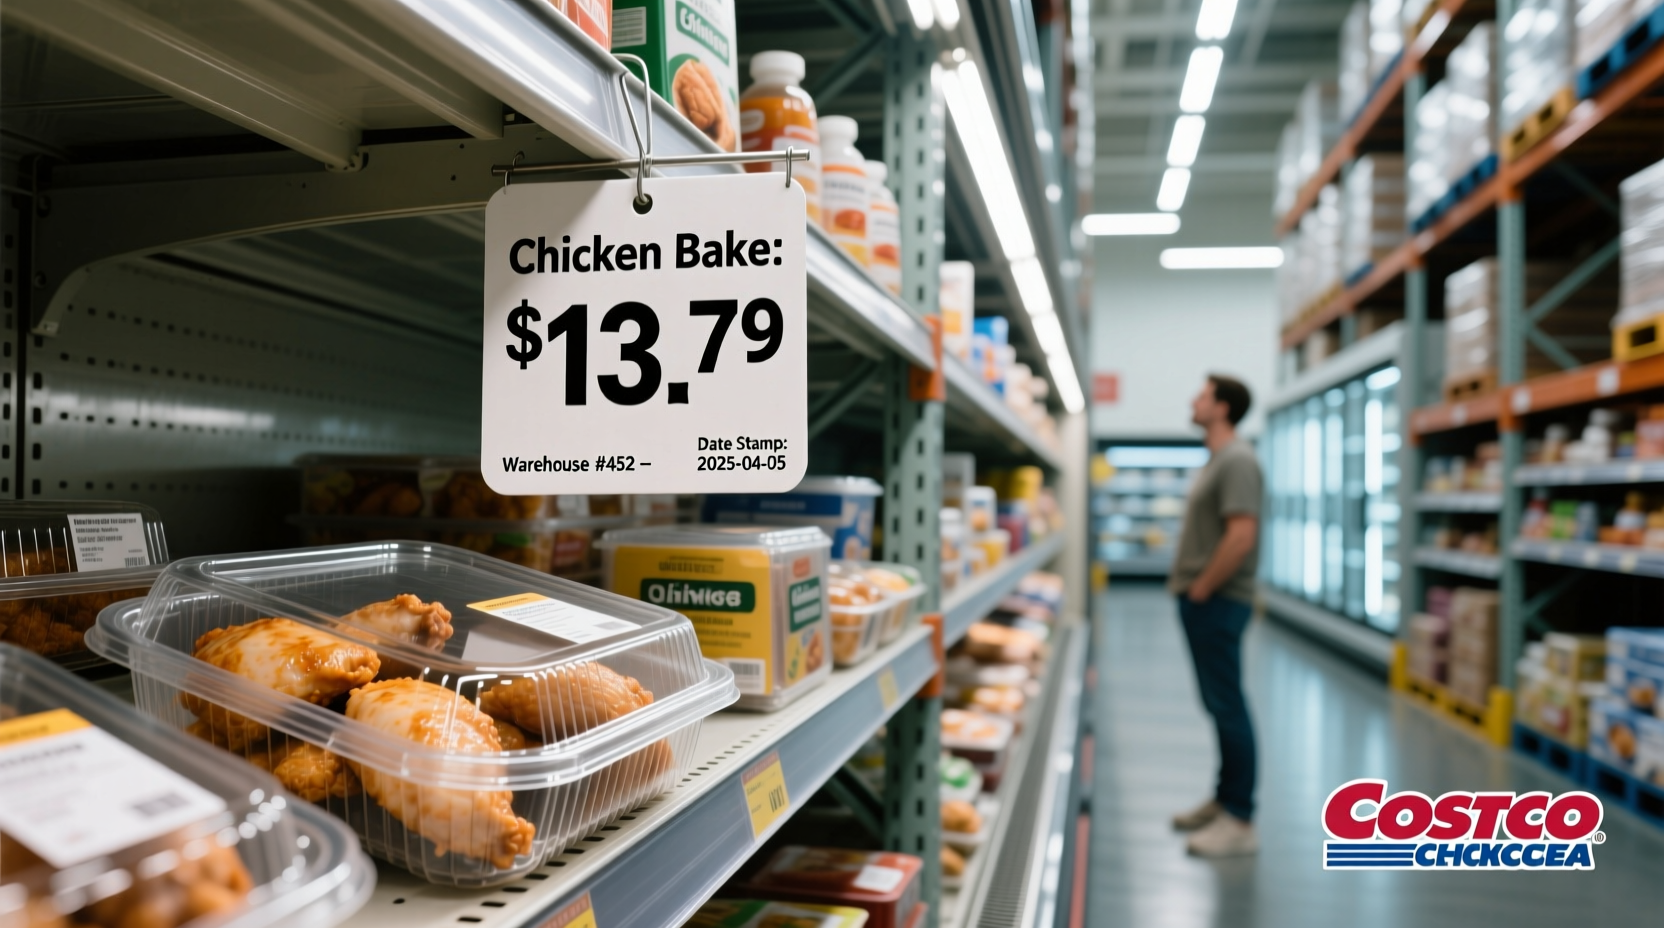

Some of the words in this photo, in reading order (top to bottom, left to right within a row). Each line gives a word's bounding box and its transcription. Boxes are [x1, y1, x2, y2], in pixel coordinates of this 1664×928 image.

[509, 234, 662, 275] Chicken
[675, 230, 783, 269] Bake:
[506, 298, 784, 406] $13.79
[697, 436, 733, 452] Date
[736, 436, 788, 453] Stamp:
[502, 455, 590, 473] Warehouse
[595, 455, 636, 472] #452
[697, 455, 787, 472] 2025-04-05
